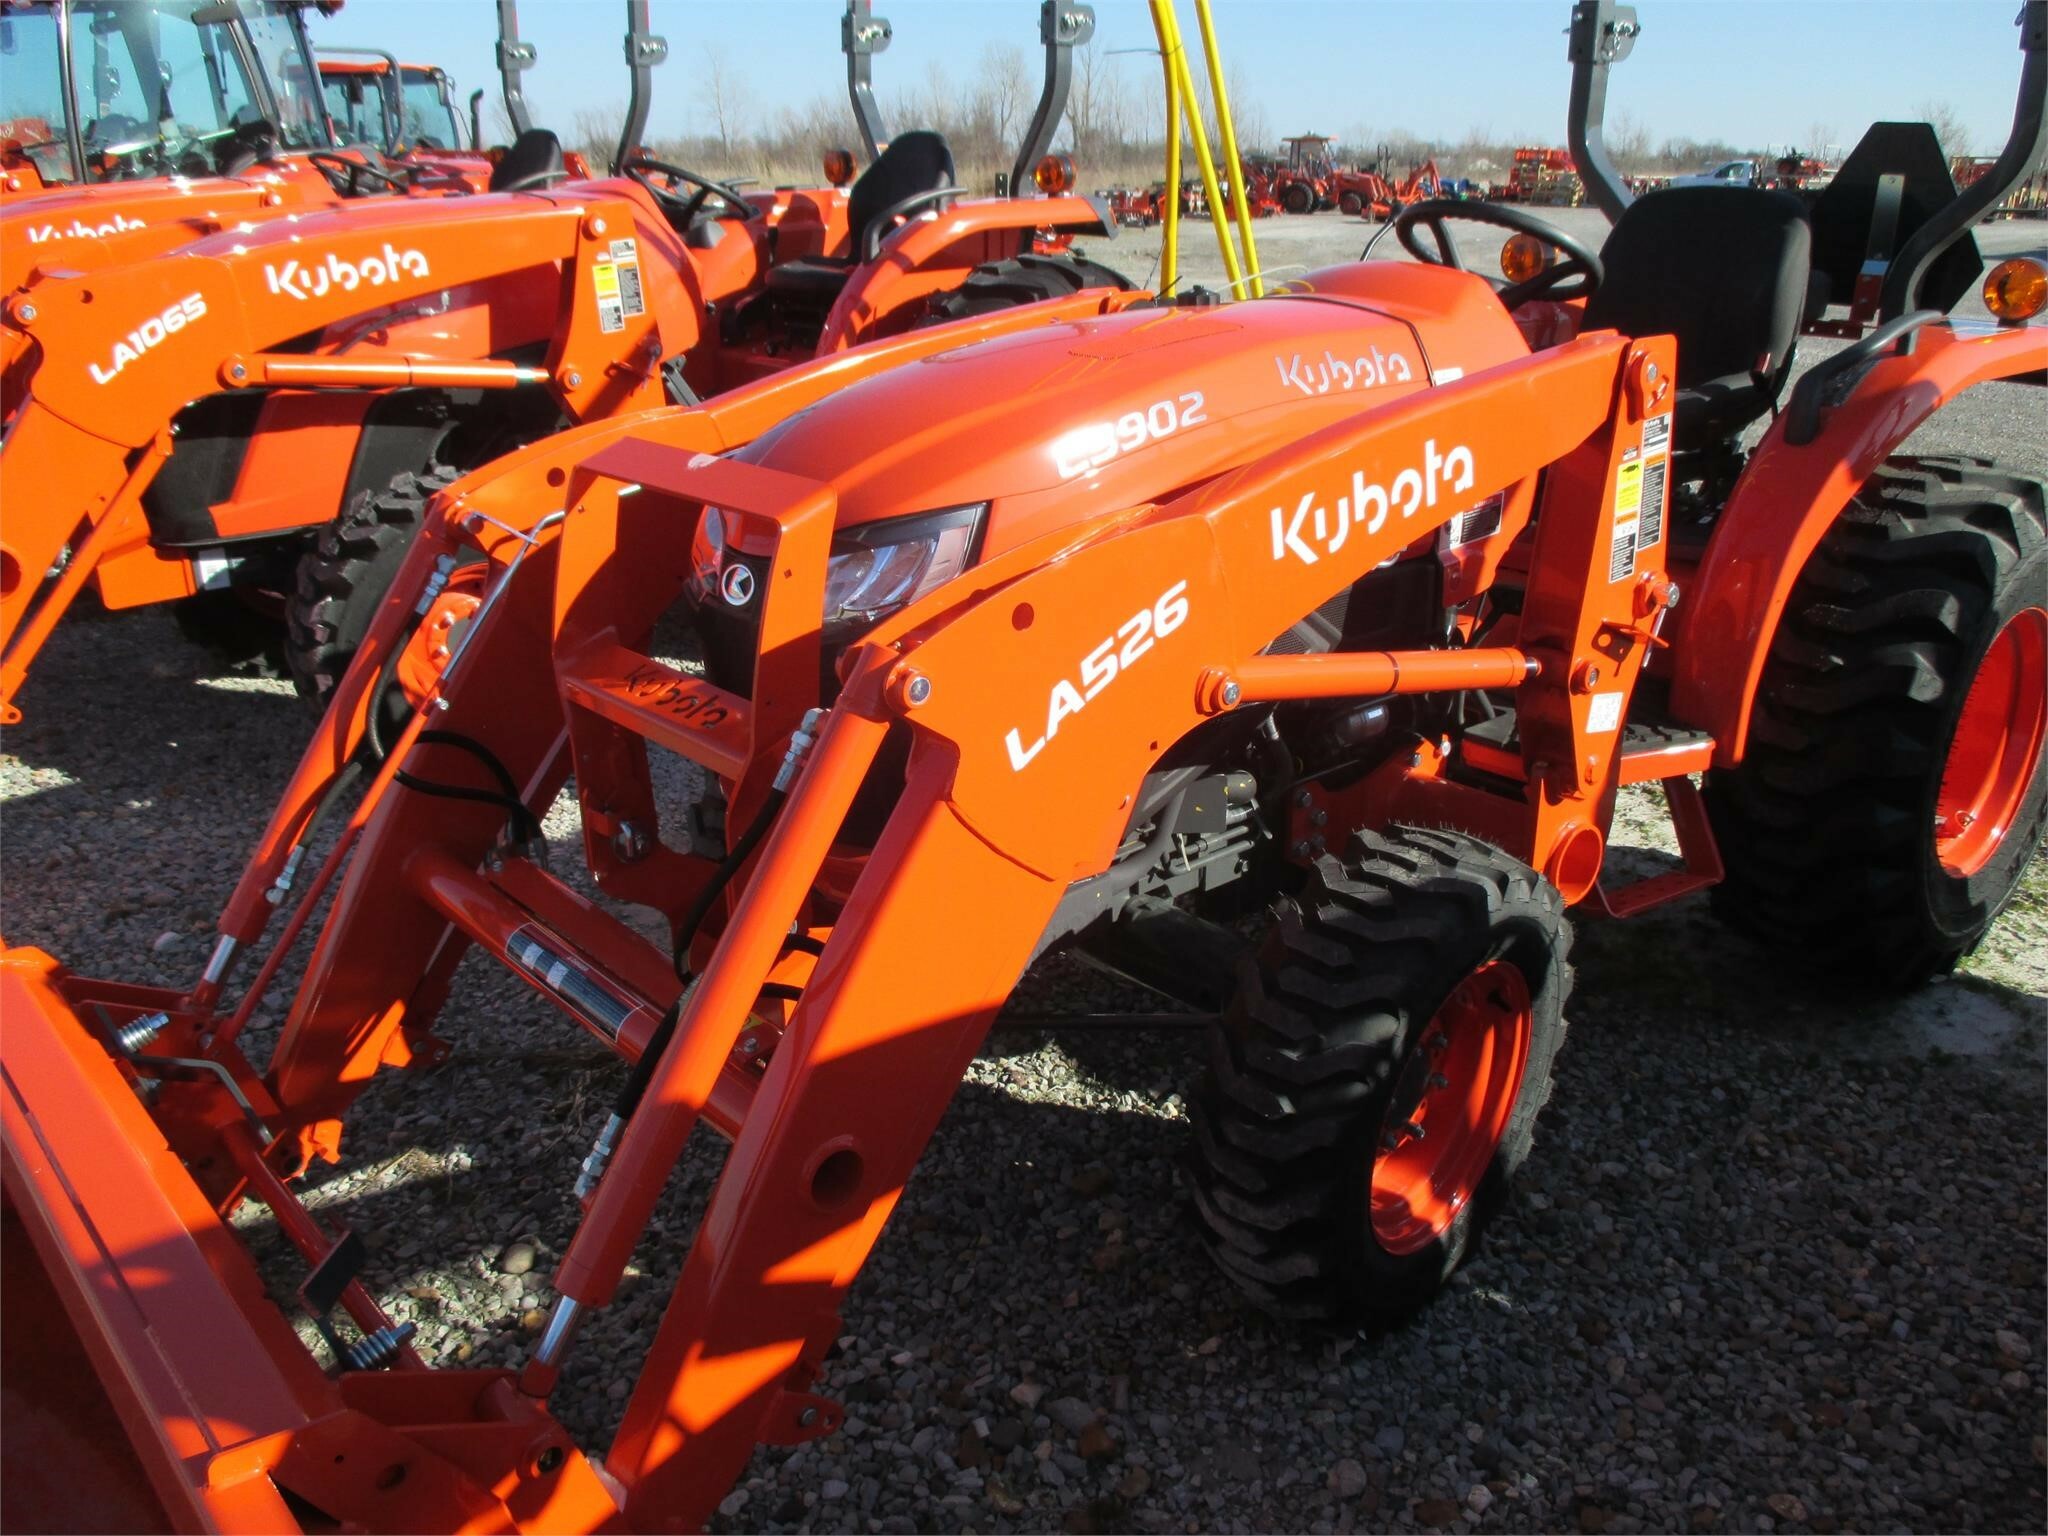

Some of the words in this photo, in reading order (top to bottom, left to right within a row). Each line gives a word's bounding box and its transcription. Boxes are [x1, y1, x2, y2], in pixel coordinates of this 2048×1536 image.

[264, 243, 430, 300] Kubota
[88, 292, 207, 386] LA1065
[1273, 343, 1413, 396] Kubota
[1270, 438, 1475, 566] Kubota
[1004, 579, 1190, 773] LA526
